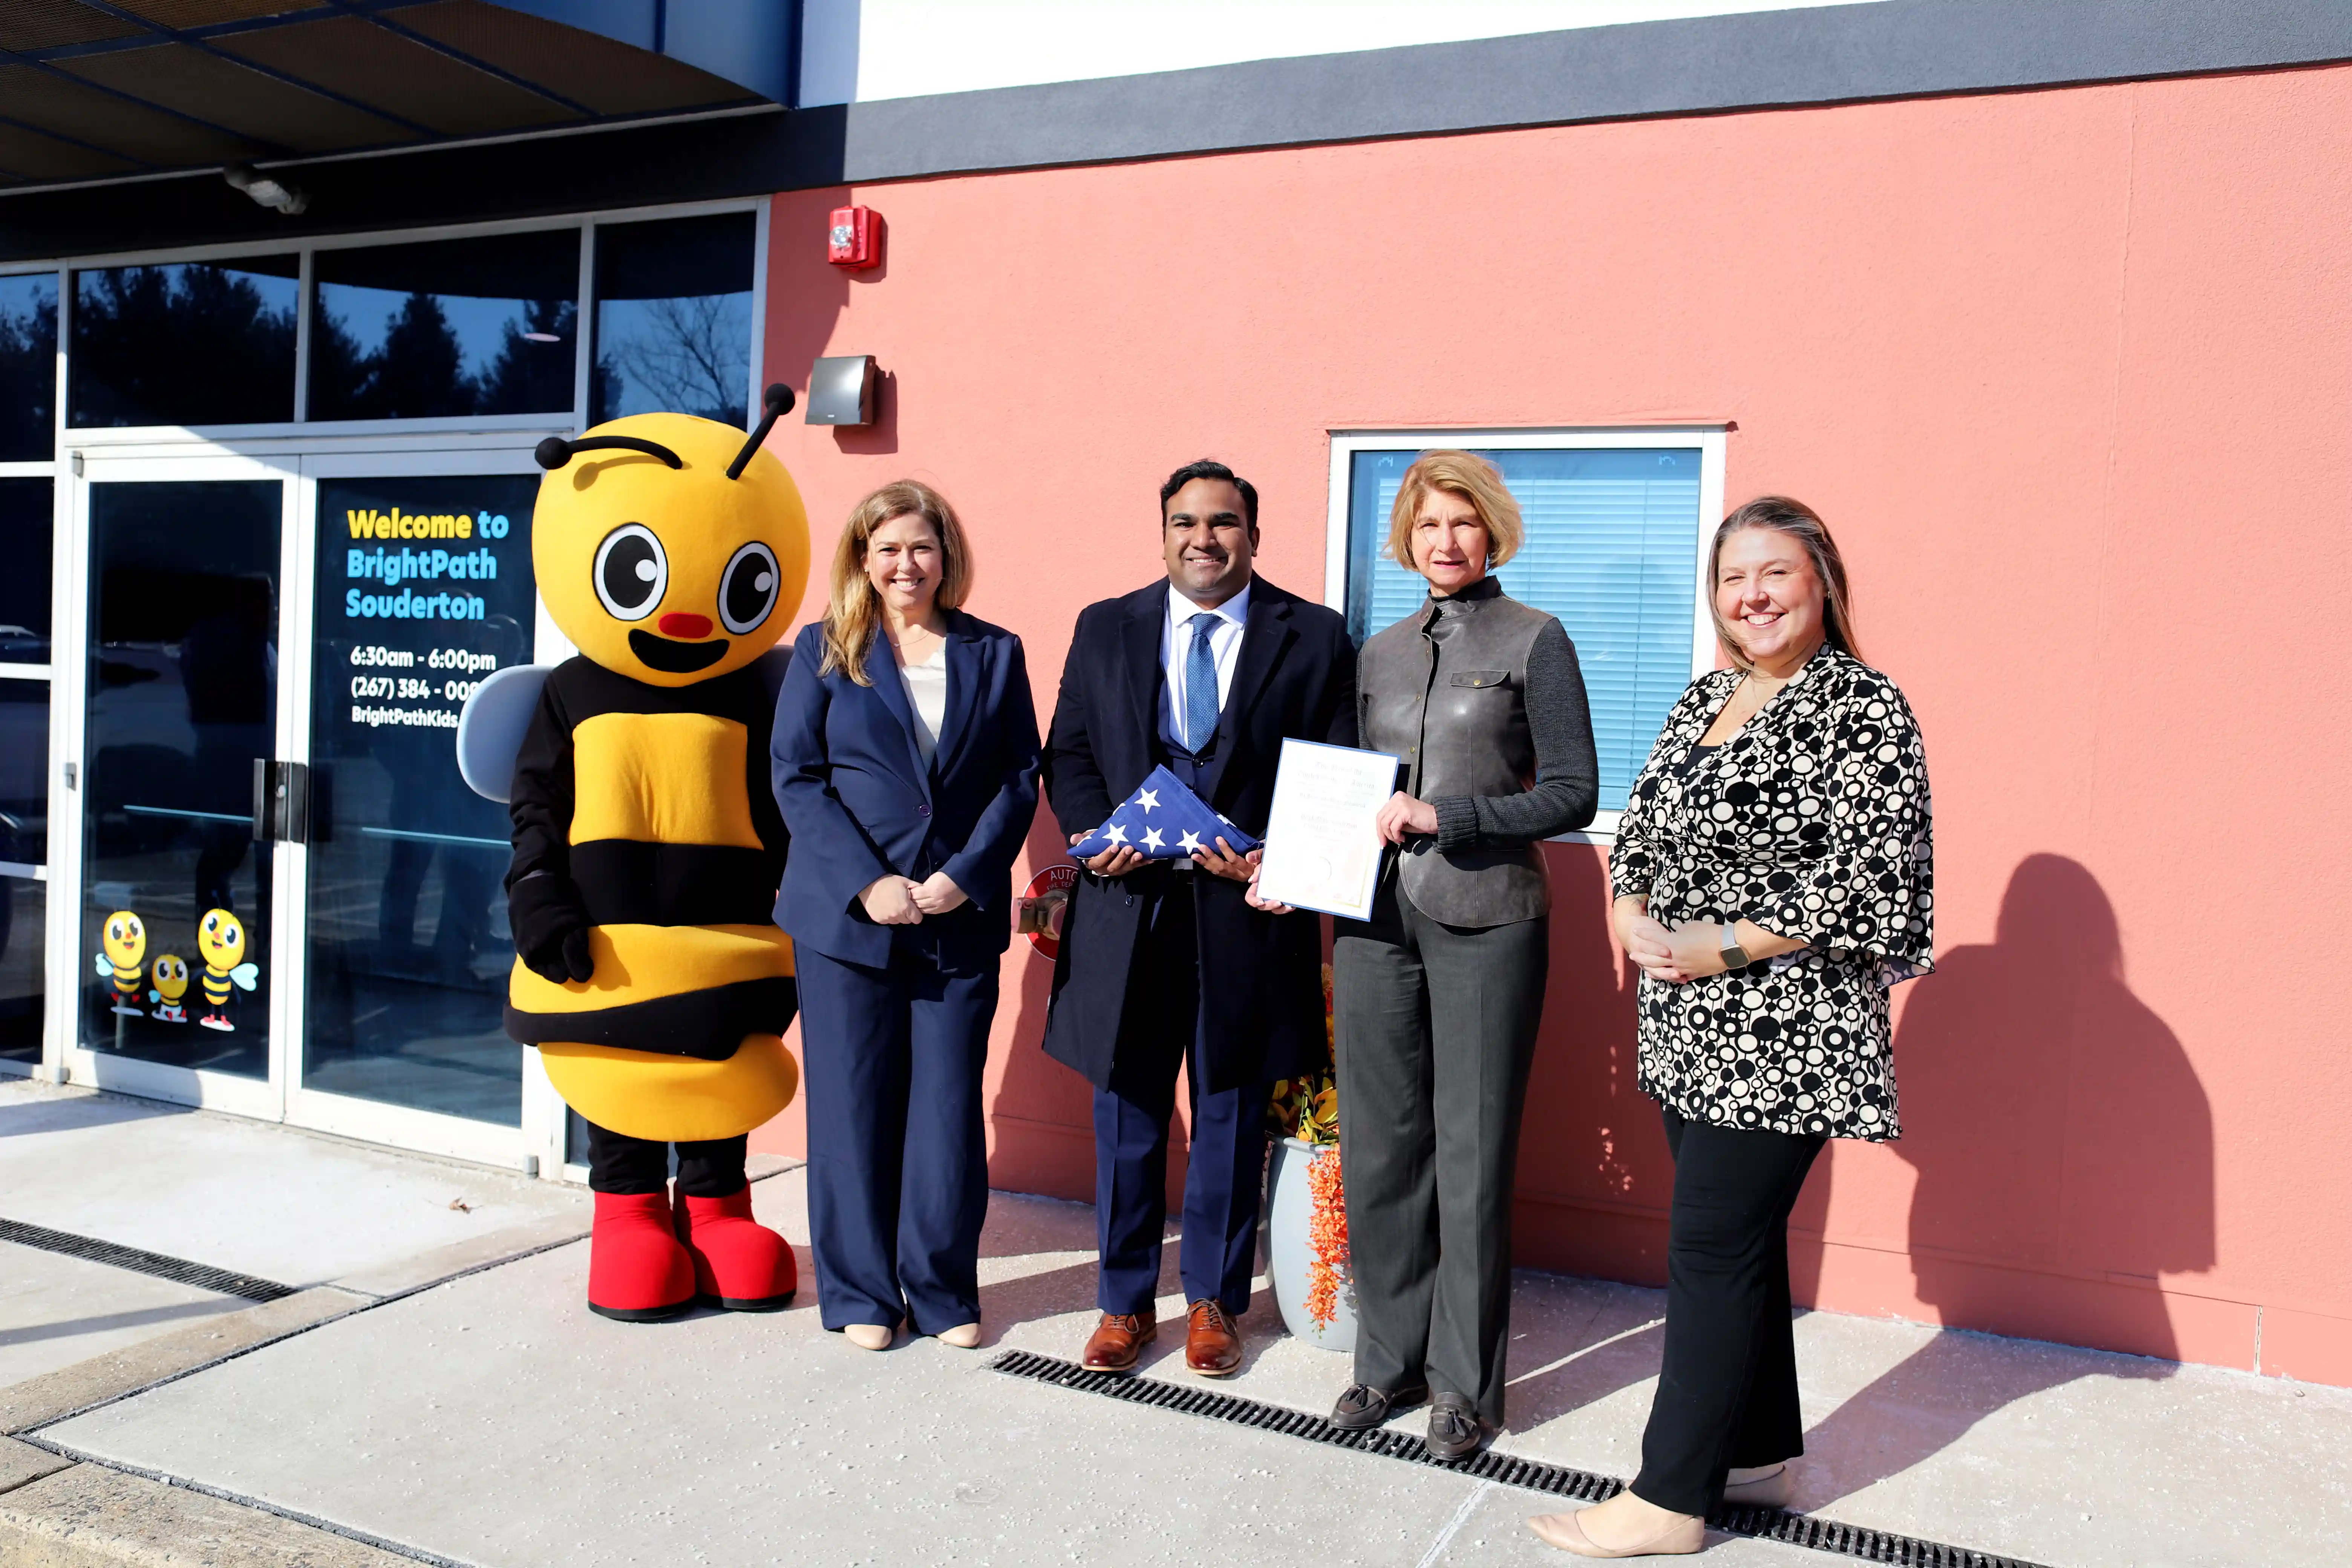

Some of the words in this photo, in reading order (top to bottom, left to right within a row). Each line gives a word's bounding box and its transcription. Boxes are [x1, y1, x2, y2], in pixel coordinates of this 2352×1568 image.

[348, 508, 472, 538] Welcome
[478, 511, 509, 539] to
[348, 547, 496, 585] BrightPath
[346, 588, 484, 620] Souderton
[351, 646, 413, 667] 6:30am
[428, 648, 496, 674] 6:00pm
[351, 677, 394, 700] (267)
[398, 678, 430, 698] 384
[1047, 882, 1058, 891] FIRE
